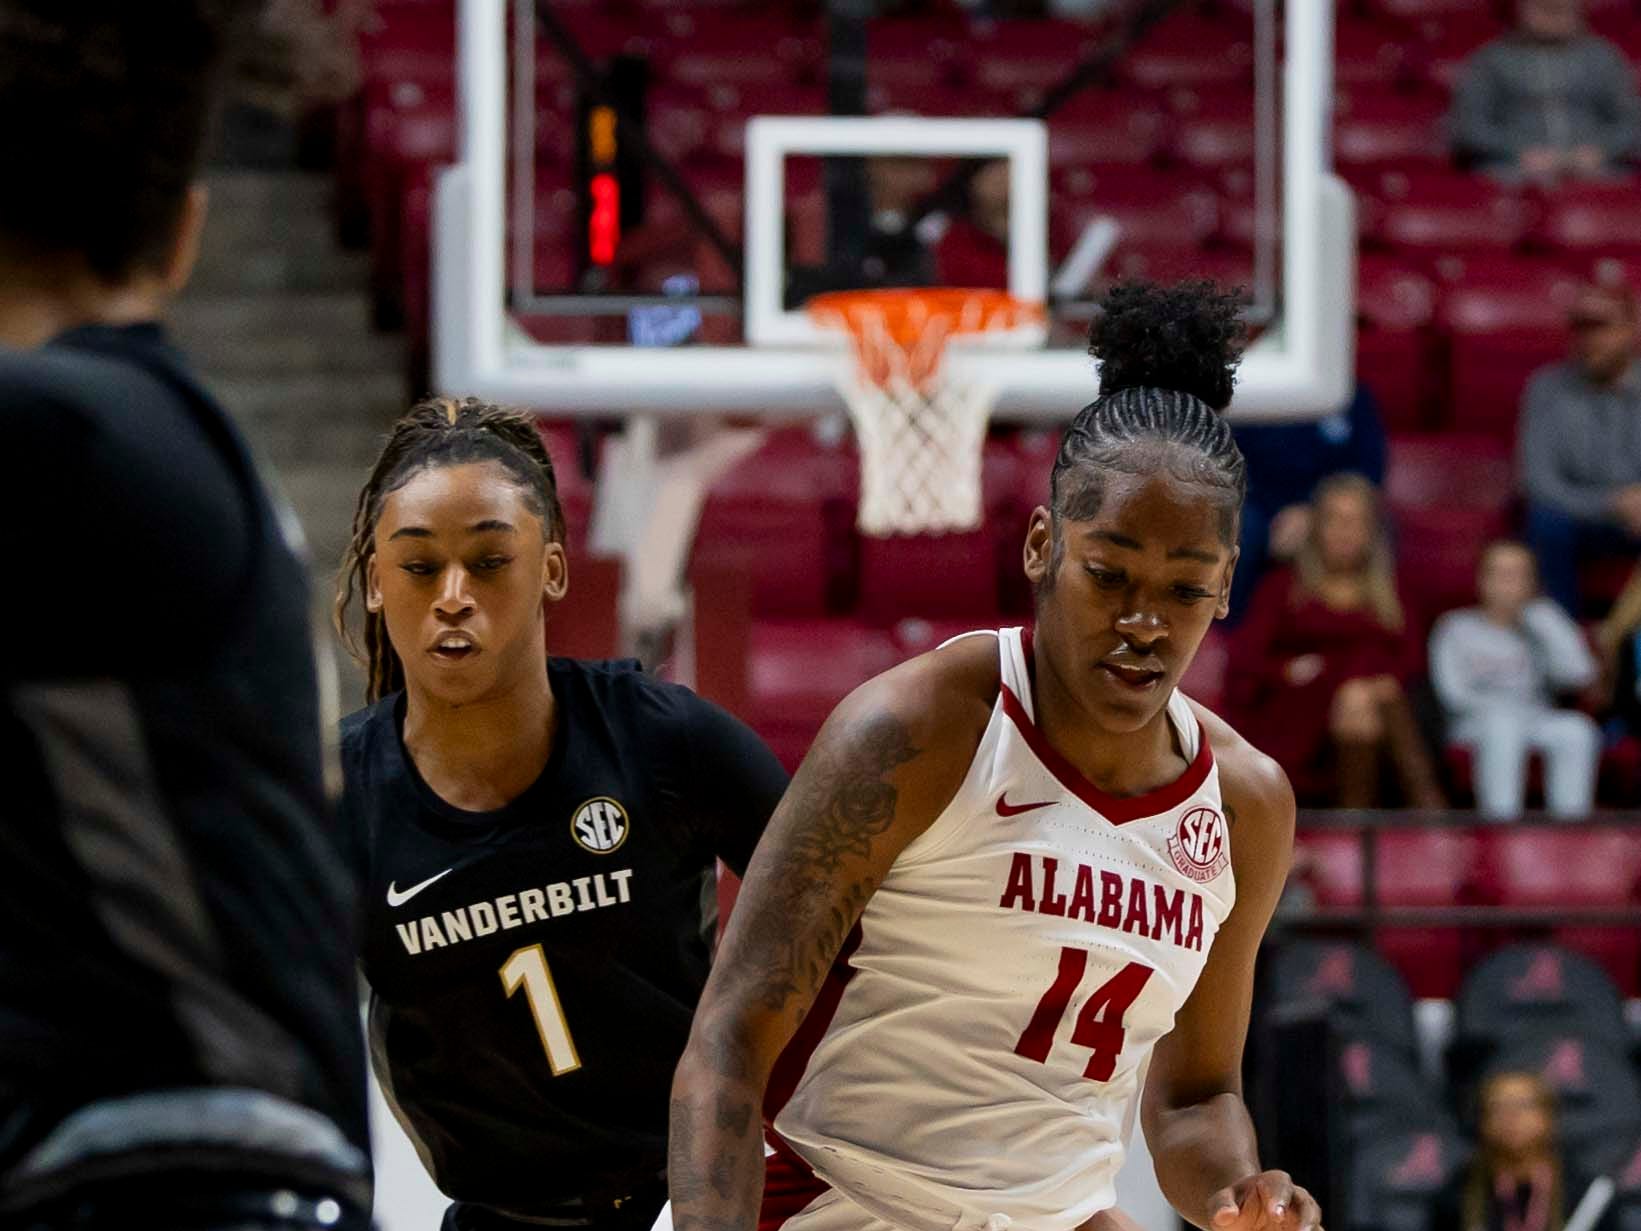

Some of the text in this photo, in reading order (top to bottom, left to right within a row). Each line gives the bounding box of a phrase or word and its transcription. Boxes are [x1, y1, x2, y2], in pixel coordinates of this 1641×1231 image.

[576, 802, 625, 850] SEC
[1182, 809, 1222, 864] SEC
[396, 869, 633, 955] VANDERBILT
[1000, 852, 1204, 952] ALABAMA
[499, 943, 582, 1077] 1
[1014, 946, 1155, 1083] 14
